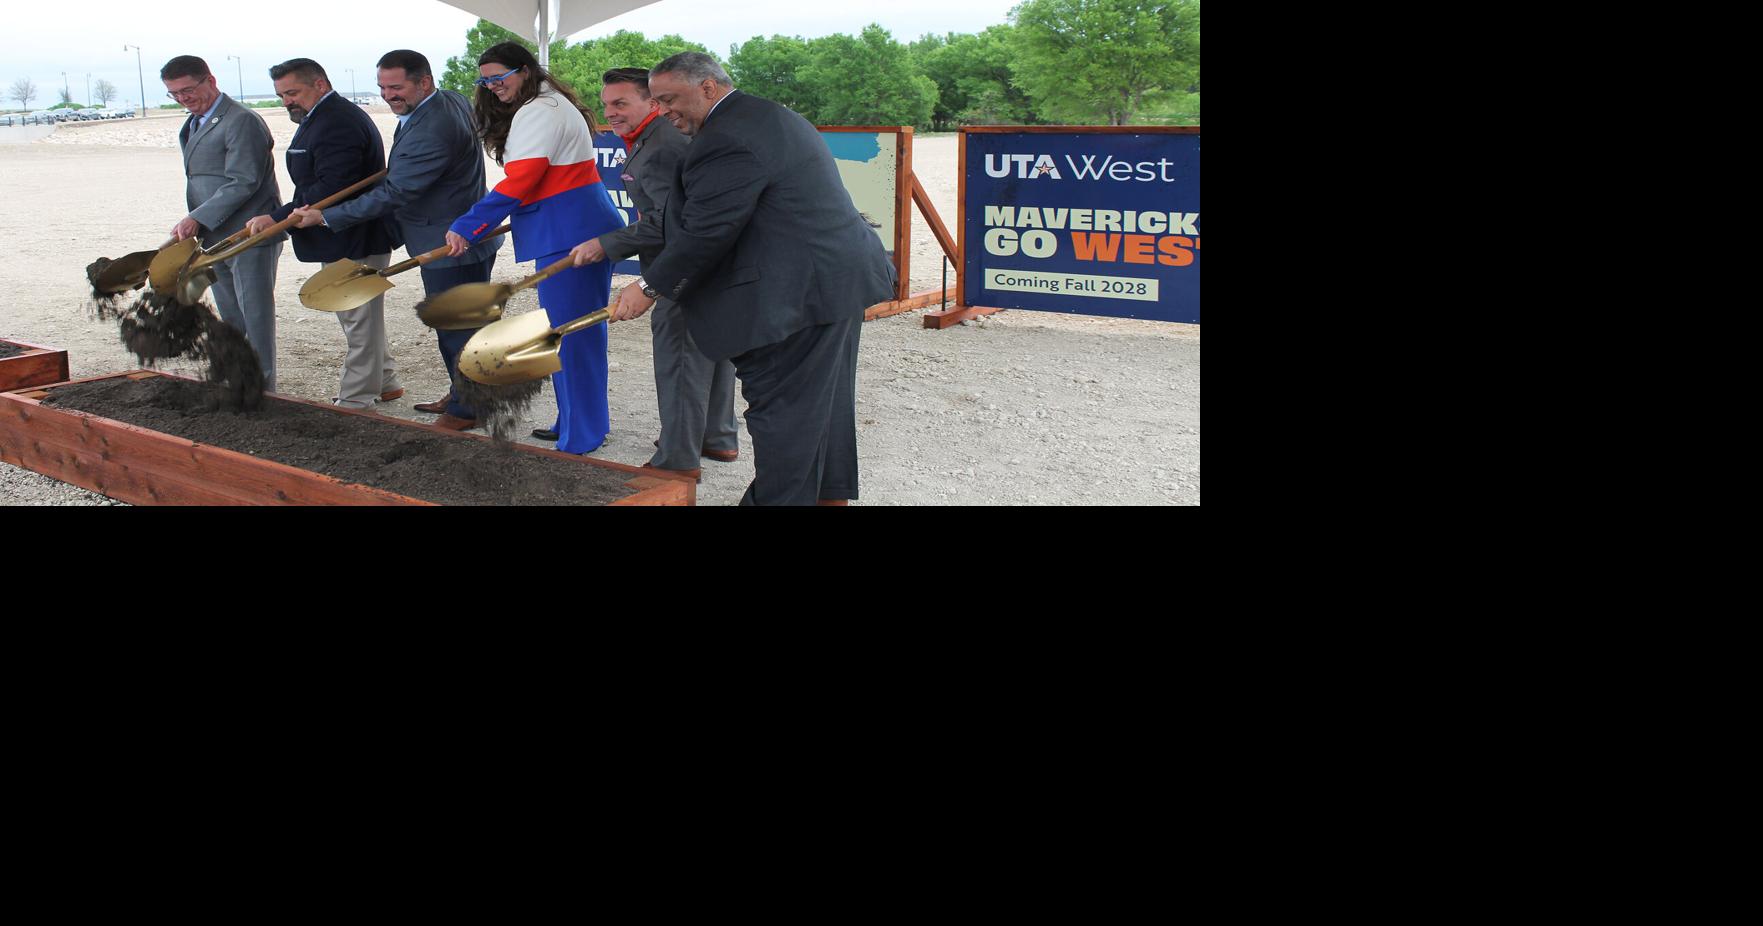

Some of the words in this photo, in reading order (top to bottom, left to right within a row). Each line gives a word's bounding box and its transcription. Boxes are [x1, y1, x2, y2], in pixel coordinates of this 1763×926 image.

[985, 153, 1062, 180] UTA
[1065, 154, 1175, 182] West
[984, 205, 1200, 236] MAVERICK
[984, 227, 1058, 259] GO
[1070, 231, 1200, 267] WES
[994, 273, 1060, 292] Coming
[1065, 278, 1096, 292] Fall
[1101, 280, 1147, 295] 2028
